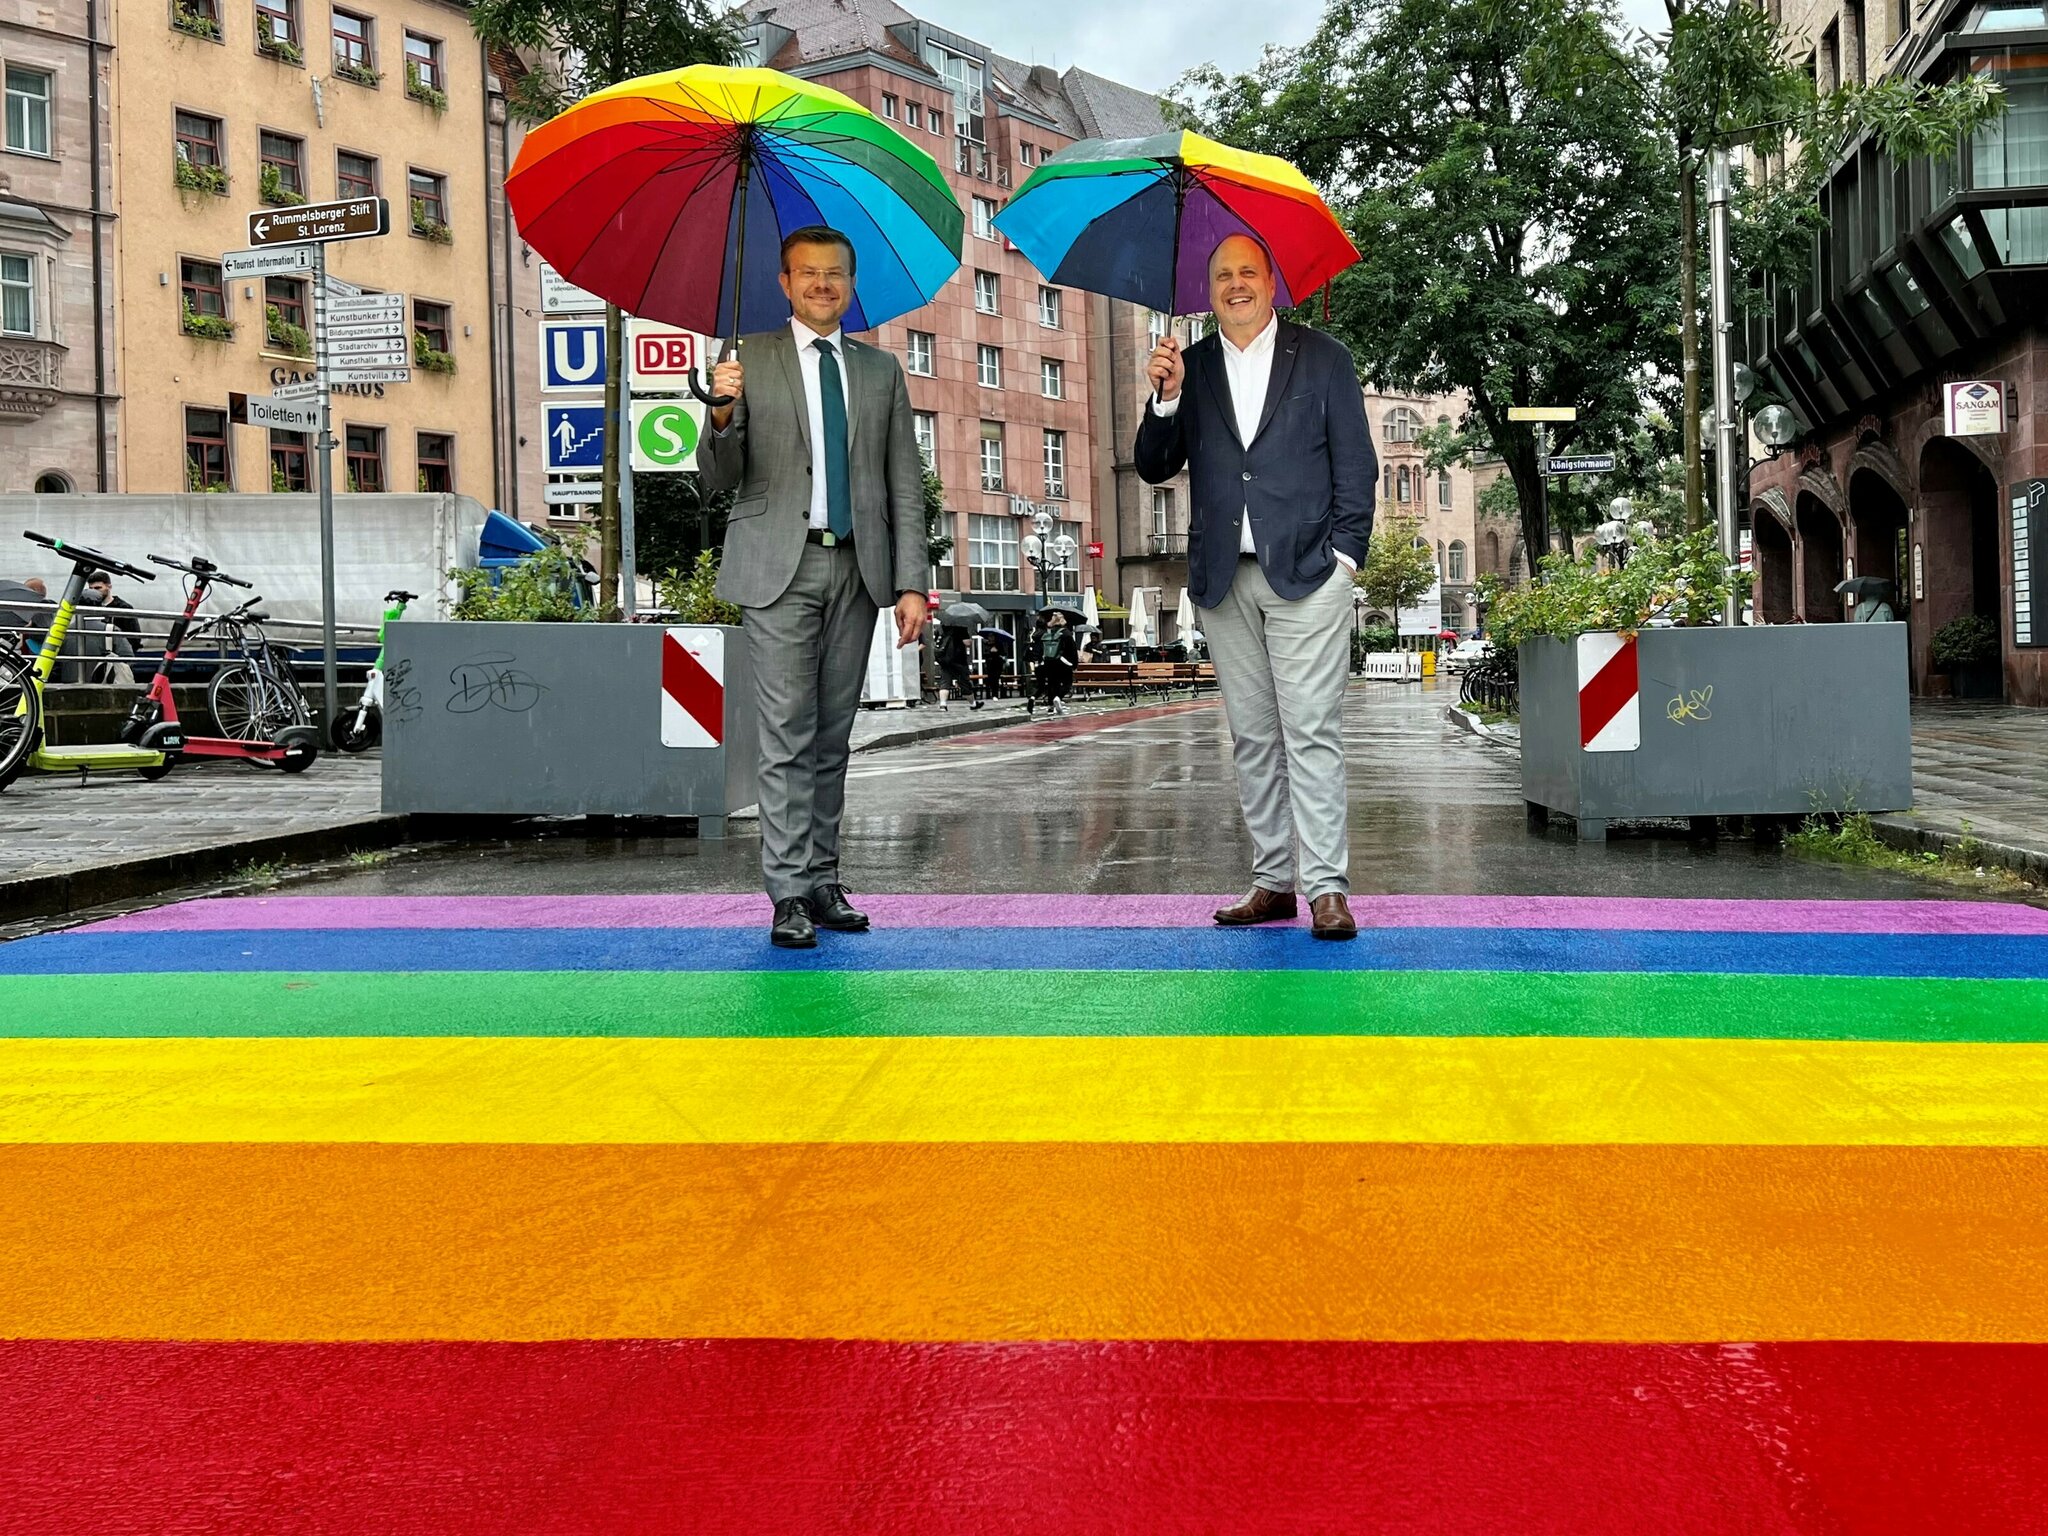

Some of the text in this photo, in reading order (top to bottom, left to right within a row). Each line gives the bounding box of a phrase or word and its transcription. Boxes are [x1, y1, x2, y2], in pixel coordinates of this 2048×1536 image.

[272, 203, 370, 225] Rummelsberger Stift
[298, 223, 346, 237] St. Lorenz
[233, 259, 255, 270] Tourist
[257, 255, 295, 267] Information
[330, 312, 380, 322] Kunstbunker
[329, 327, 384, 337] Bildungszentrum
[338, 343, 378, 351] Stadtarchiv
[643, 340, 687, 368] DB
[340, 356, 378, 365] Kunsthalle
[553, 330, 598, 382] U
[348, 372, 389, 380] Kunstvilla
[1955, 400, 1999, 410] SANGAM
[250, 403, 302, 424] Toiletten
[653, 413, 684, 457] S
[1550, 459, 1613, 470] Königstormauer
[1010, 493, 1036, 516] ibis
